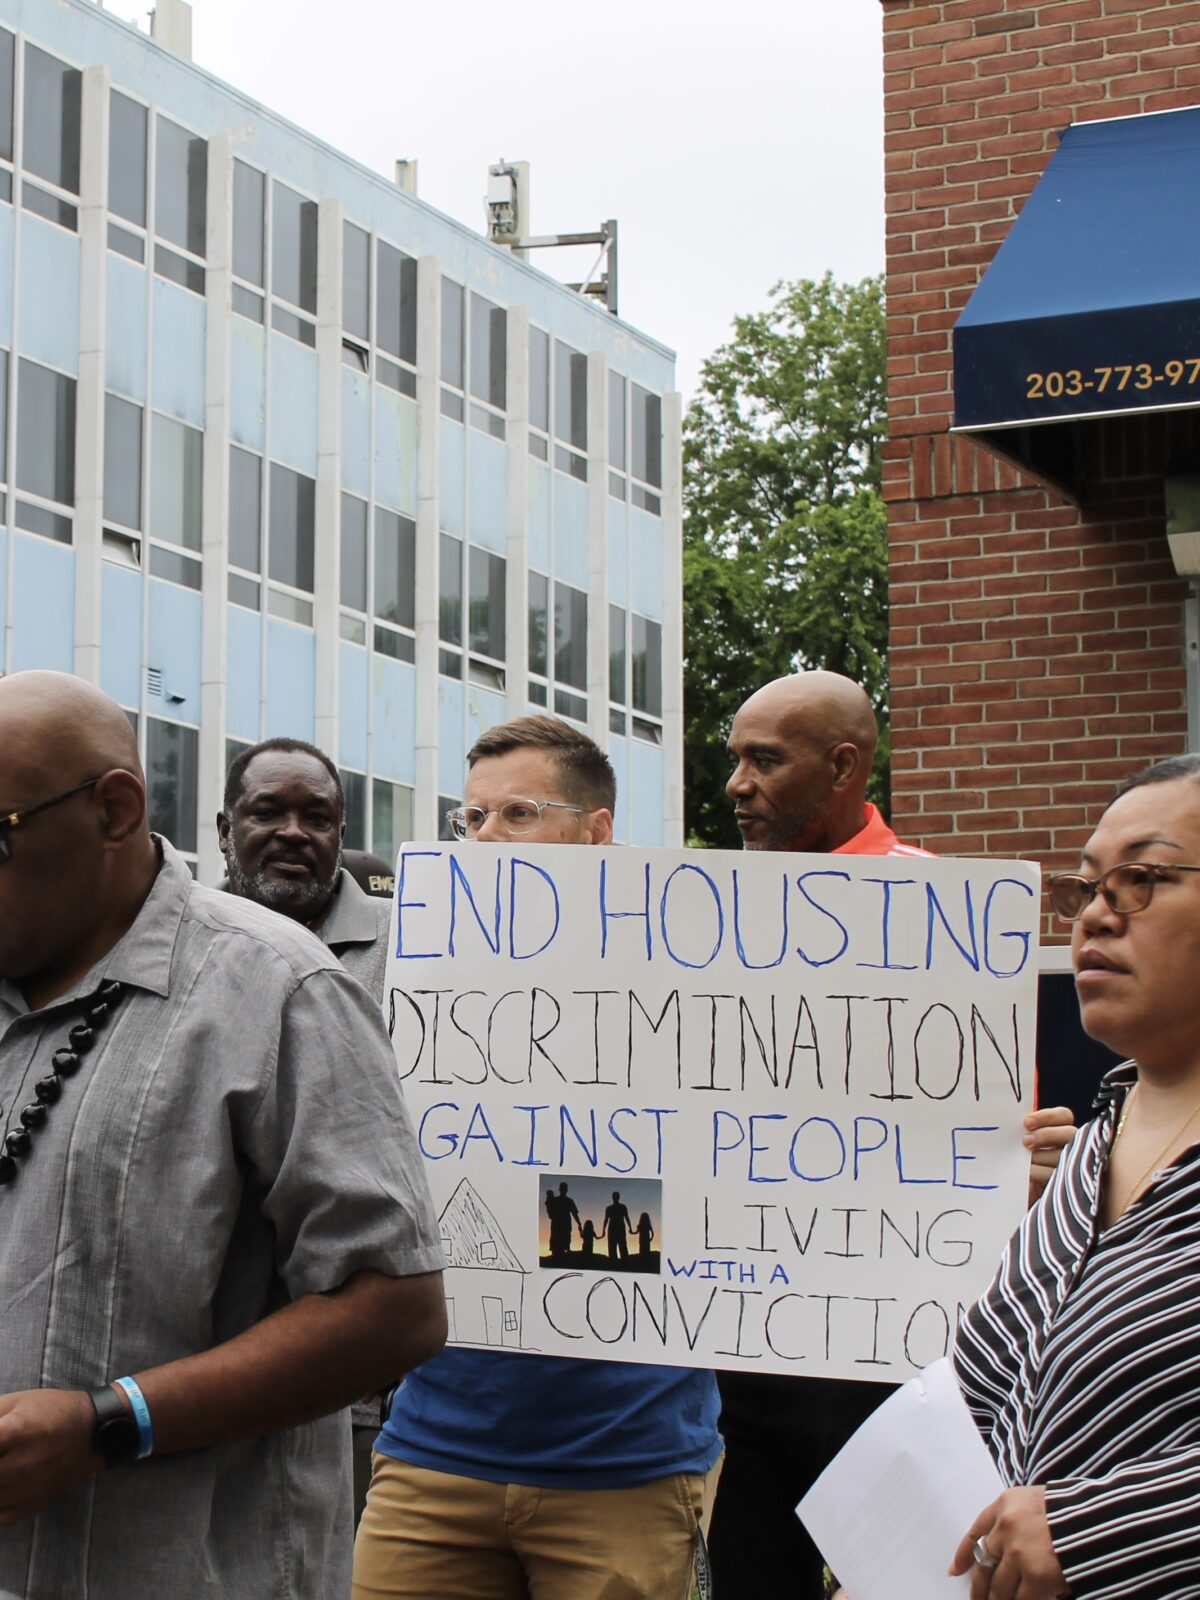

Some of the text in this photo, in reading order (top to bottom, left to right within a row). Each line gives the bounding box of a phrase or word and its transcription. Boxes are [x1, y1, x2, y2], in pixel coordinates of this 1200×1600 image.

[1025, 358, 1200, 398] 203-773-97
[396, 851, 1034, 979] END HOUSING
[389, 986, 1022, 1104] DISCRIMINATION
[418, 1102, 1000, 1191] GAINST PEOPLE
[667, 1257, 790, 1285] WITH A
[704, 1196, 974, 1267] LIVING
